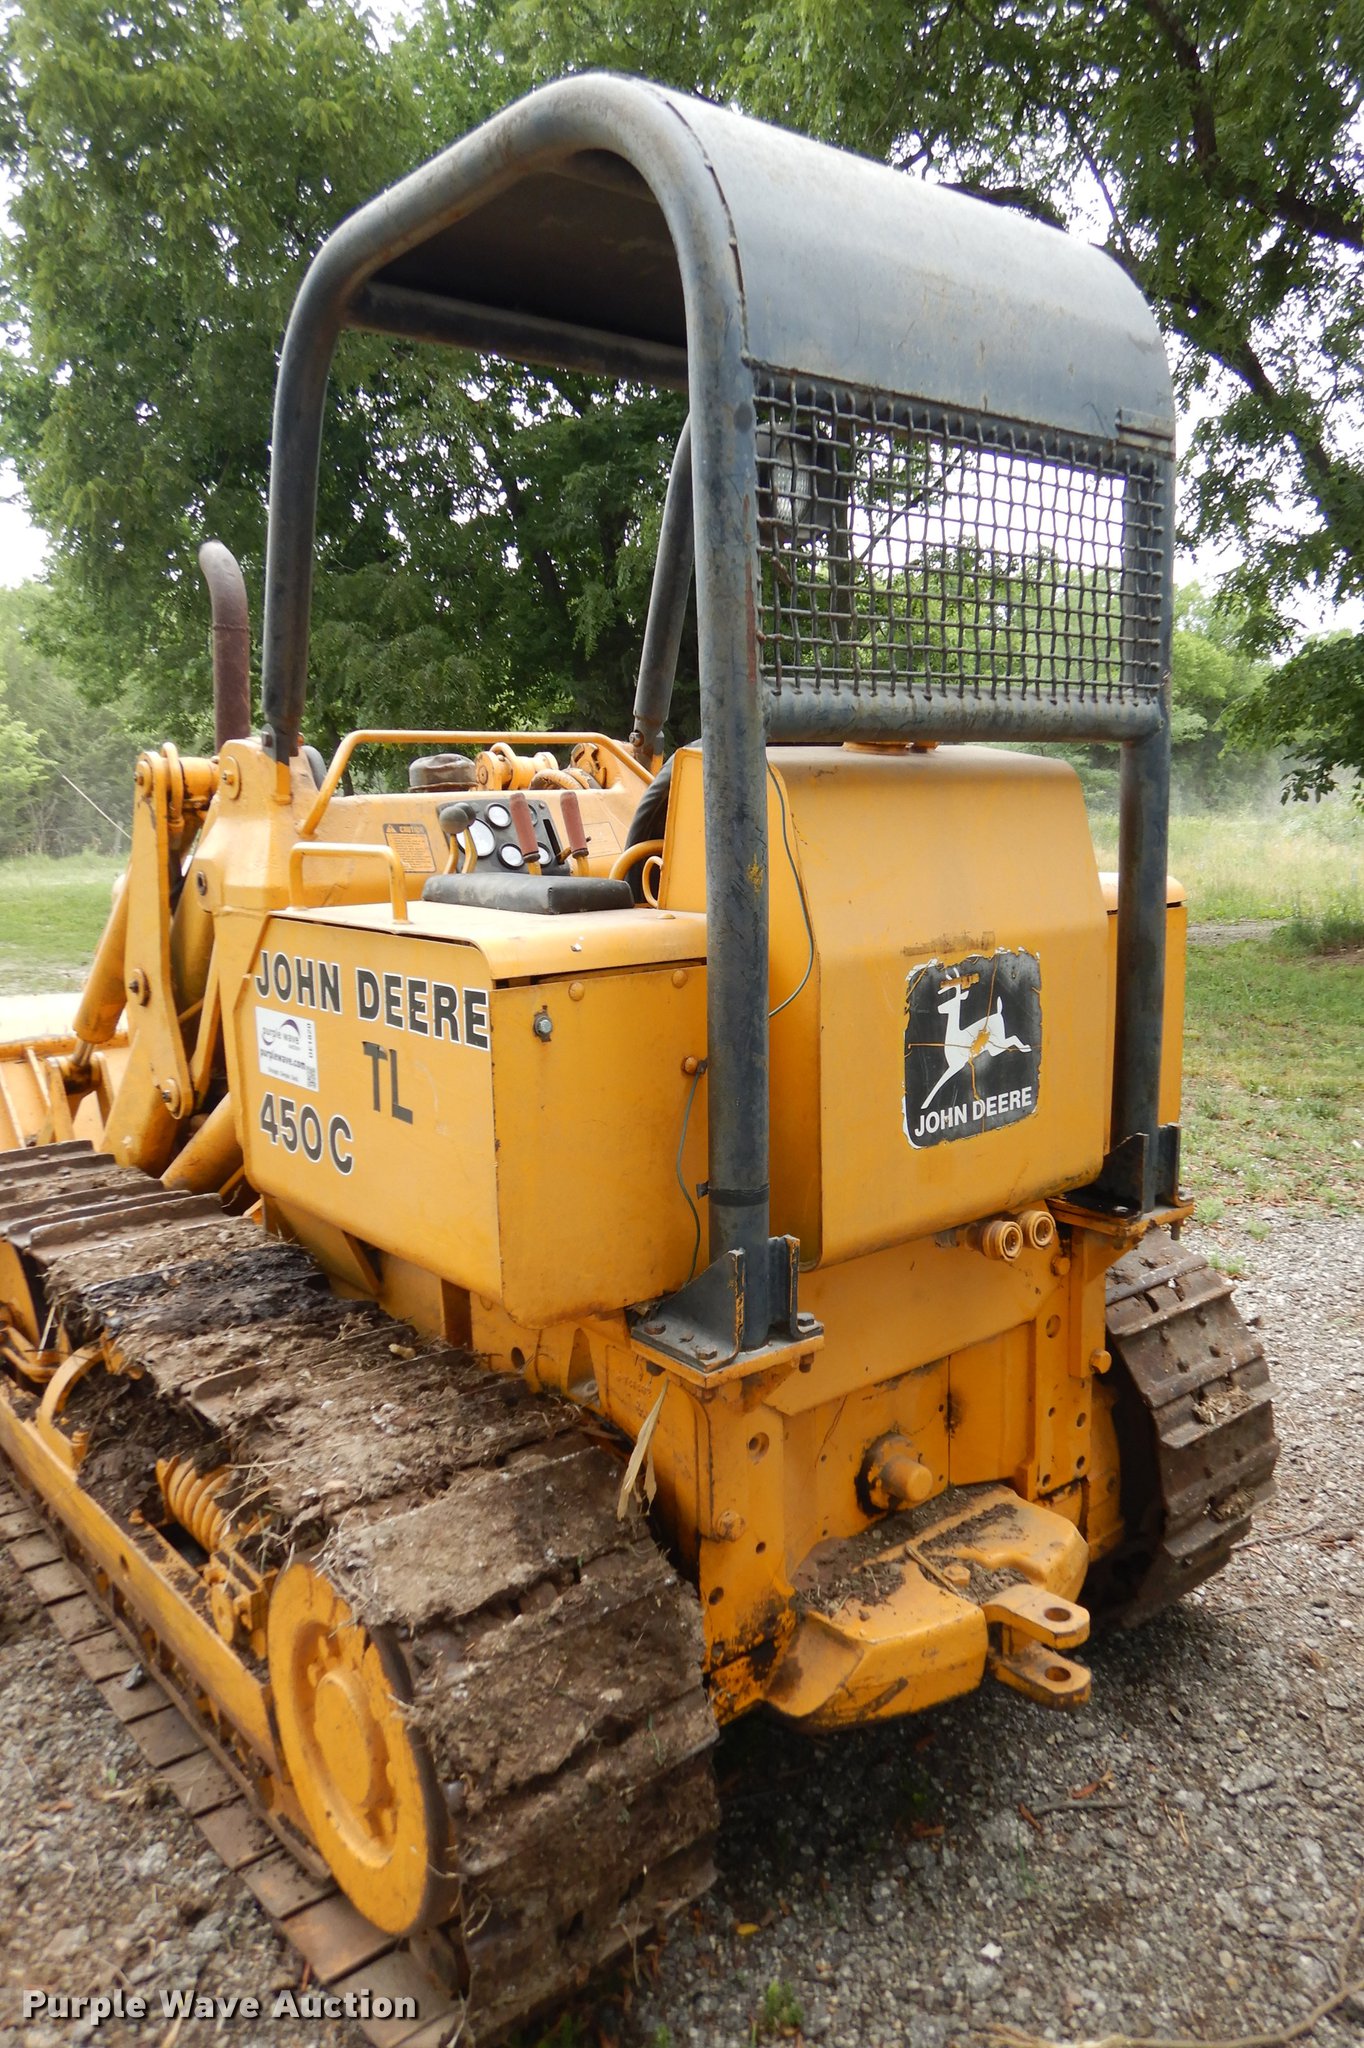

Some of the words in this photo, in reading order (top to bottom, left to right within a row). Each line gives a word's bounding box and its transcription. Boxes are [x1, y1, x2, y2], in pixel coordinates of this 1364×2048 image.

[255, 950, 343, 1015] JOHN
[355, 967, 490, 1051] DEERE
[362, 1041, 413, 1125] TL
[914, 1103, 968, 1137] JOHN
[972, 1086, 1032, 1121] DEERE
